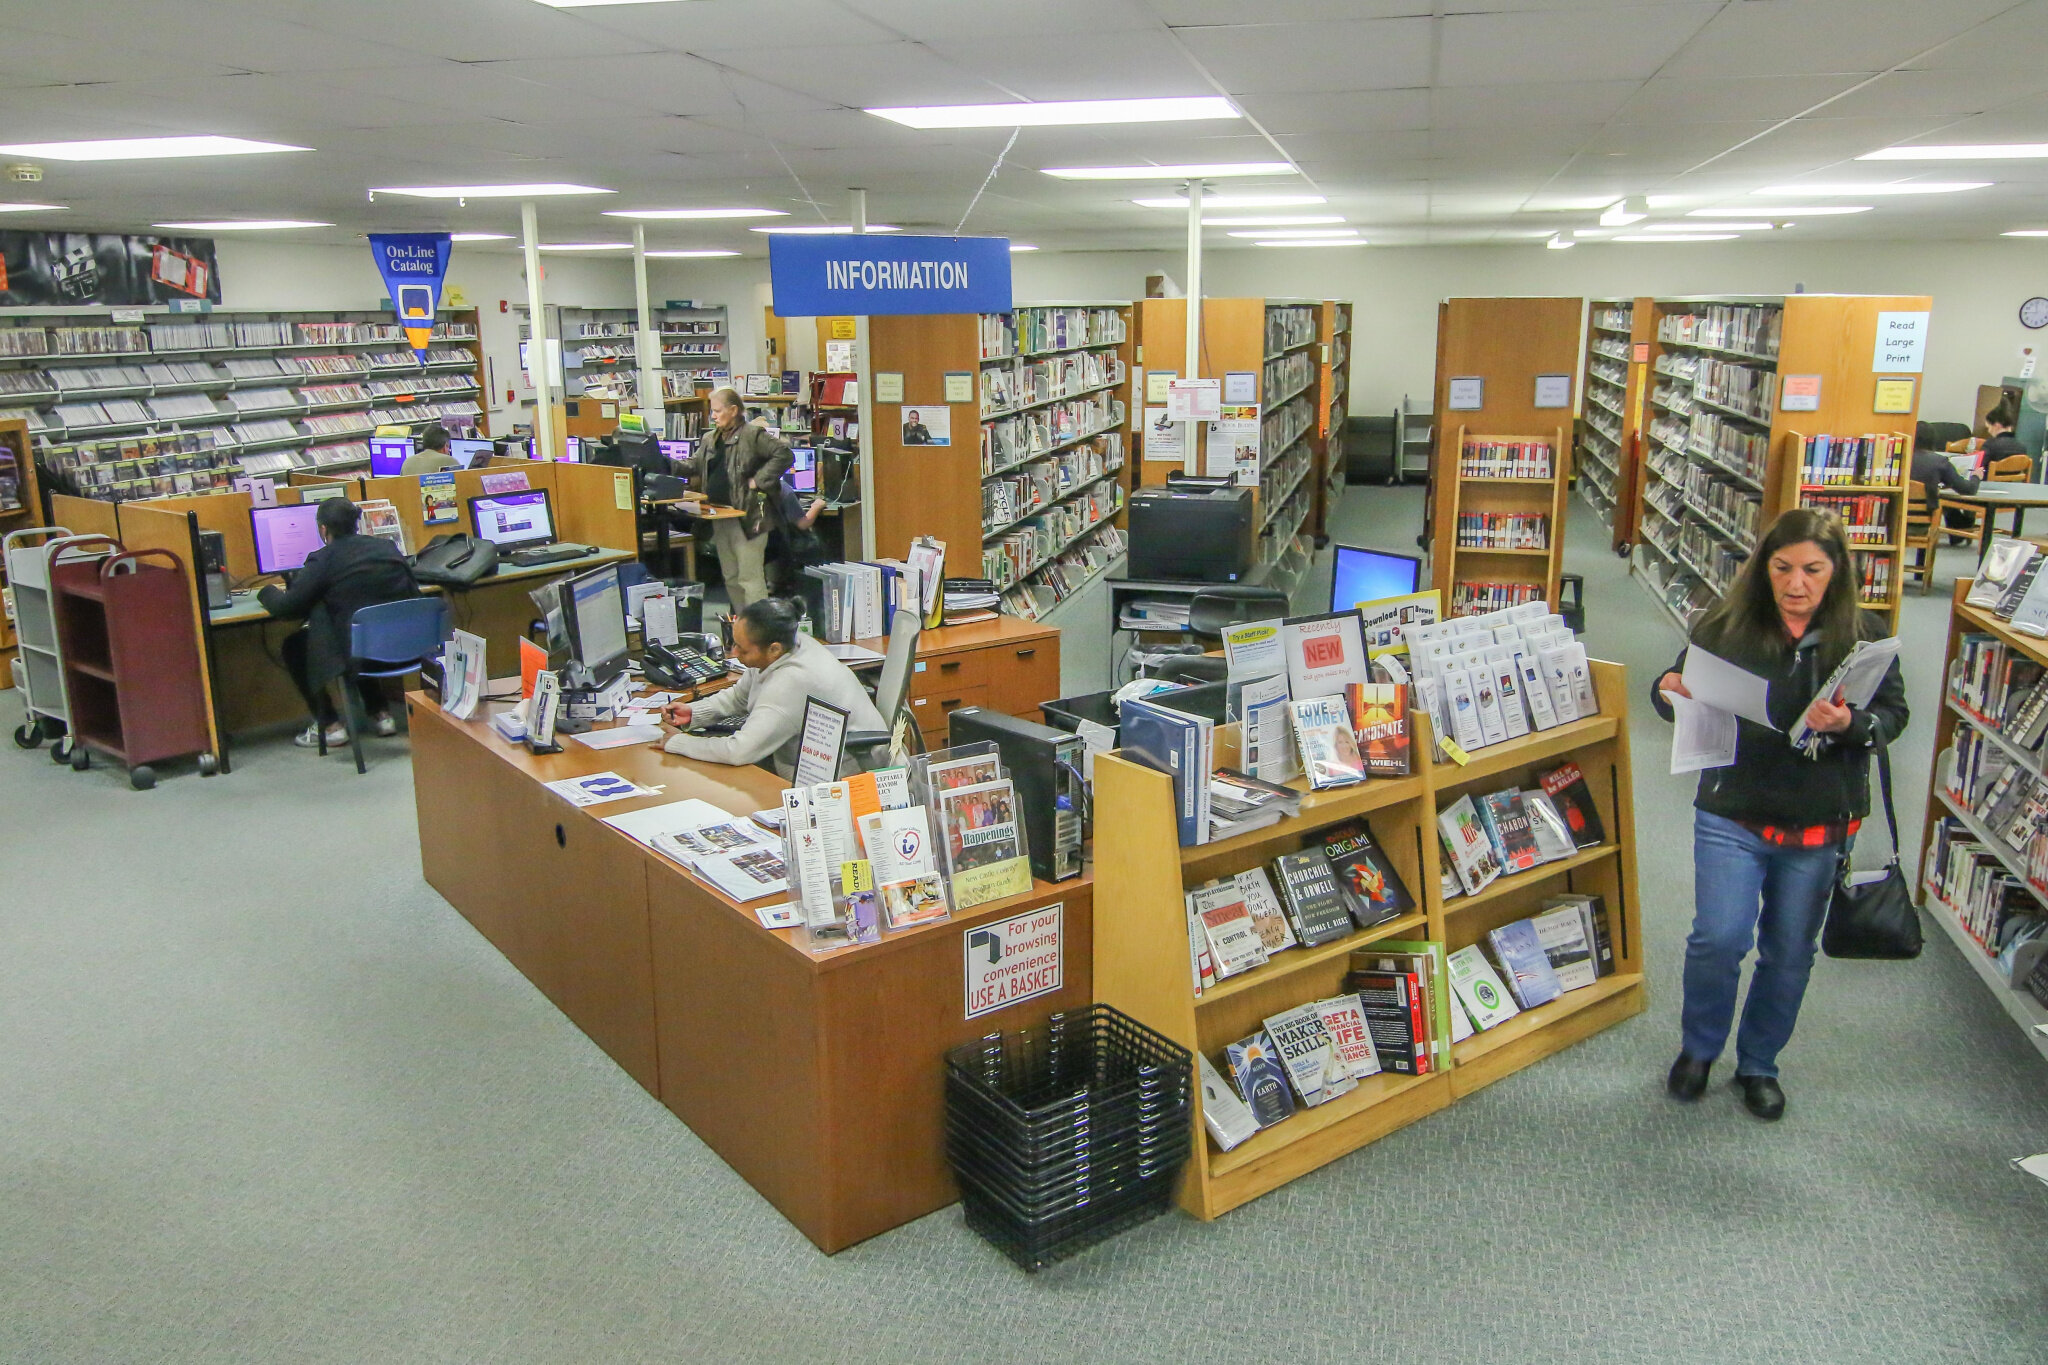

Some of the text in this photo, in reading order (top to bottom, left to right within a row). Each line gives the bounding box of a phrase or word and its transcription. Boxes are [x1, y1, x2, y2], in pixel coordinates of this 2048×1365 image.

[386, 245, 435, 258] On-Line
[390, 259, 434, 275] Catalog
[825, 260, 968, 290] INFORMATION
[1889, 321, 1915, 330] Read
[1885, 338, 1914, 348] Large
[1885, 354, 1910, 362] Print
[452, 423, 458, 434] 4
[834, 424, 841, 436] 8
[258, 484, 270, 501] 1
[1363, 607, 1398, 629] Download
[1414, 605, 1434, 615] Browse
[1244, 630, 1256, 638] Staff
[1299, 620, 1342, 634] Recently
[1306, 641, 1340, 663] NEW
[1297, 701, 1328, 719] LOVE
[1302, 709, 1345, 729] MONEY
[1354, 719, 1404, 744] CANDIDATE
[802, 745, 833, 763] SIGN UP NOW!
[1370, 759, 1405, 767] WIEHL
[876, 773, 903, 783] CEPTABLE
[877, 781, 898, 789] HAVIOR
[1549, 771, 1564, 784] KILL
[1558, 770, 1582, 789] KILLED
[1497, 815, 1529, 835] CHABON
[963, 825, 1014, 846] Happenings
[1325, 833, 1370, 857] ORIGAMI
[851, 862, 860, 891] READ!
[965, 873, 978, 883] New
[1287, 863, 1332, 885] CHURCHILL
[1240, 880, 1261, 895] BIRTH
[1295, 880, 1335, 900] & ORWELL
[1247, 892, 1262, 902] YOU
[1247, 899, 1268, 912] DON'T
[1008, 913, 1057, 937] For your
[1305, 924, 1326, 936] THOMAS
[1333, 916, 1349, 926] RICKS
[1005, 932, 1057, 957] browsing
[1222, 930, 1248, 945] CONTROL
[983, 951, 1057, 983] convenience
[970, 965, 1058, 1010] USE A BASKET
[1272, 1012, 1318, 1035] THE BIG BOOK OF
[1322, 1008, 1360, 1026] GET A
[1275, 1019, 1326, 1048] MAKER
[1328, 1020, 1362, 1032] INANCIAL
[1335, 1026, 1366, 1046] IFE
[1283, 1031, 1332, 1061] SKILLS
[1340, 1043, 1369, 1054] RSONAL
[1345, 1049, 1371, 1061] ANCE
[1256, 1081, 1278, 1097] EARTH
